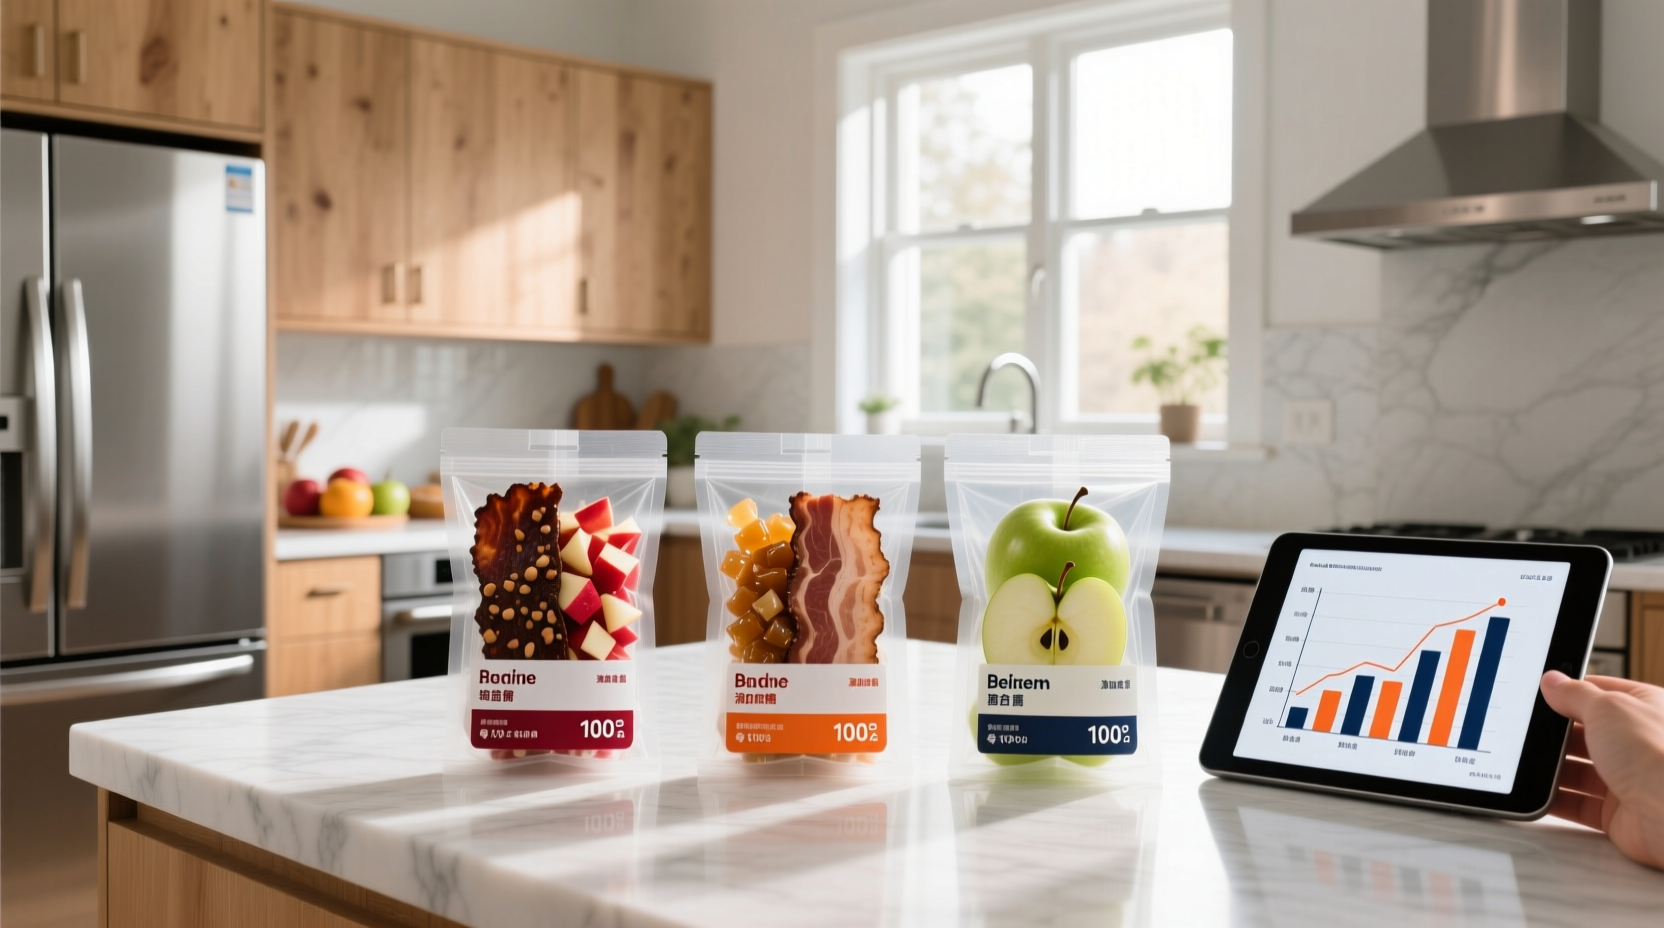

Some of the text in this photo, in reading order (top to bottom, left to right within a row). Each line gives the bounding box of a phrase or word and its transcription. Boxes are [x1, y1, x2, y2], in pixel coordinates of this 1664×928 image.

[580, 719, 615, 738] 100
[833, 723, 868, 742] 100
[1088, 725, 1121, 744] 100
